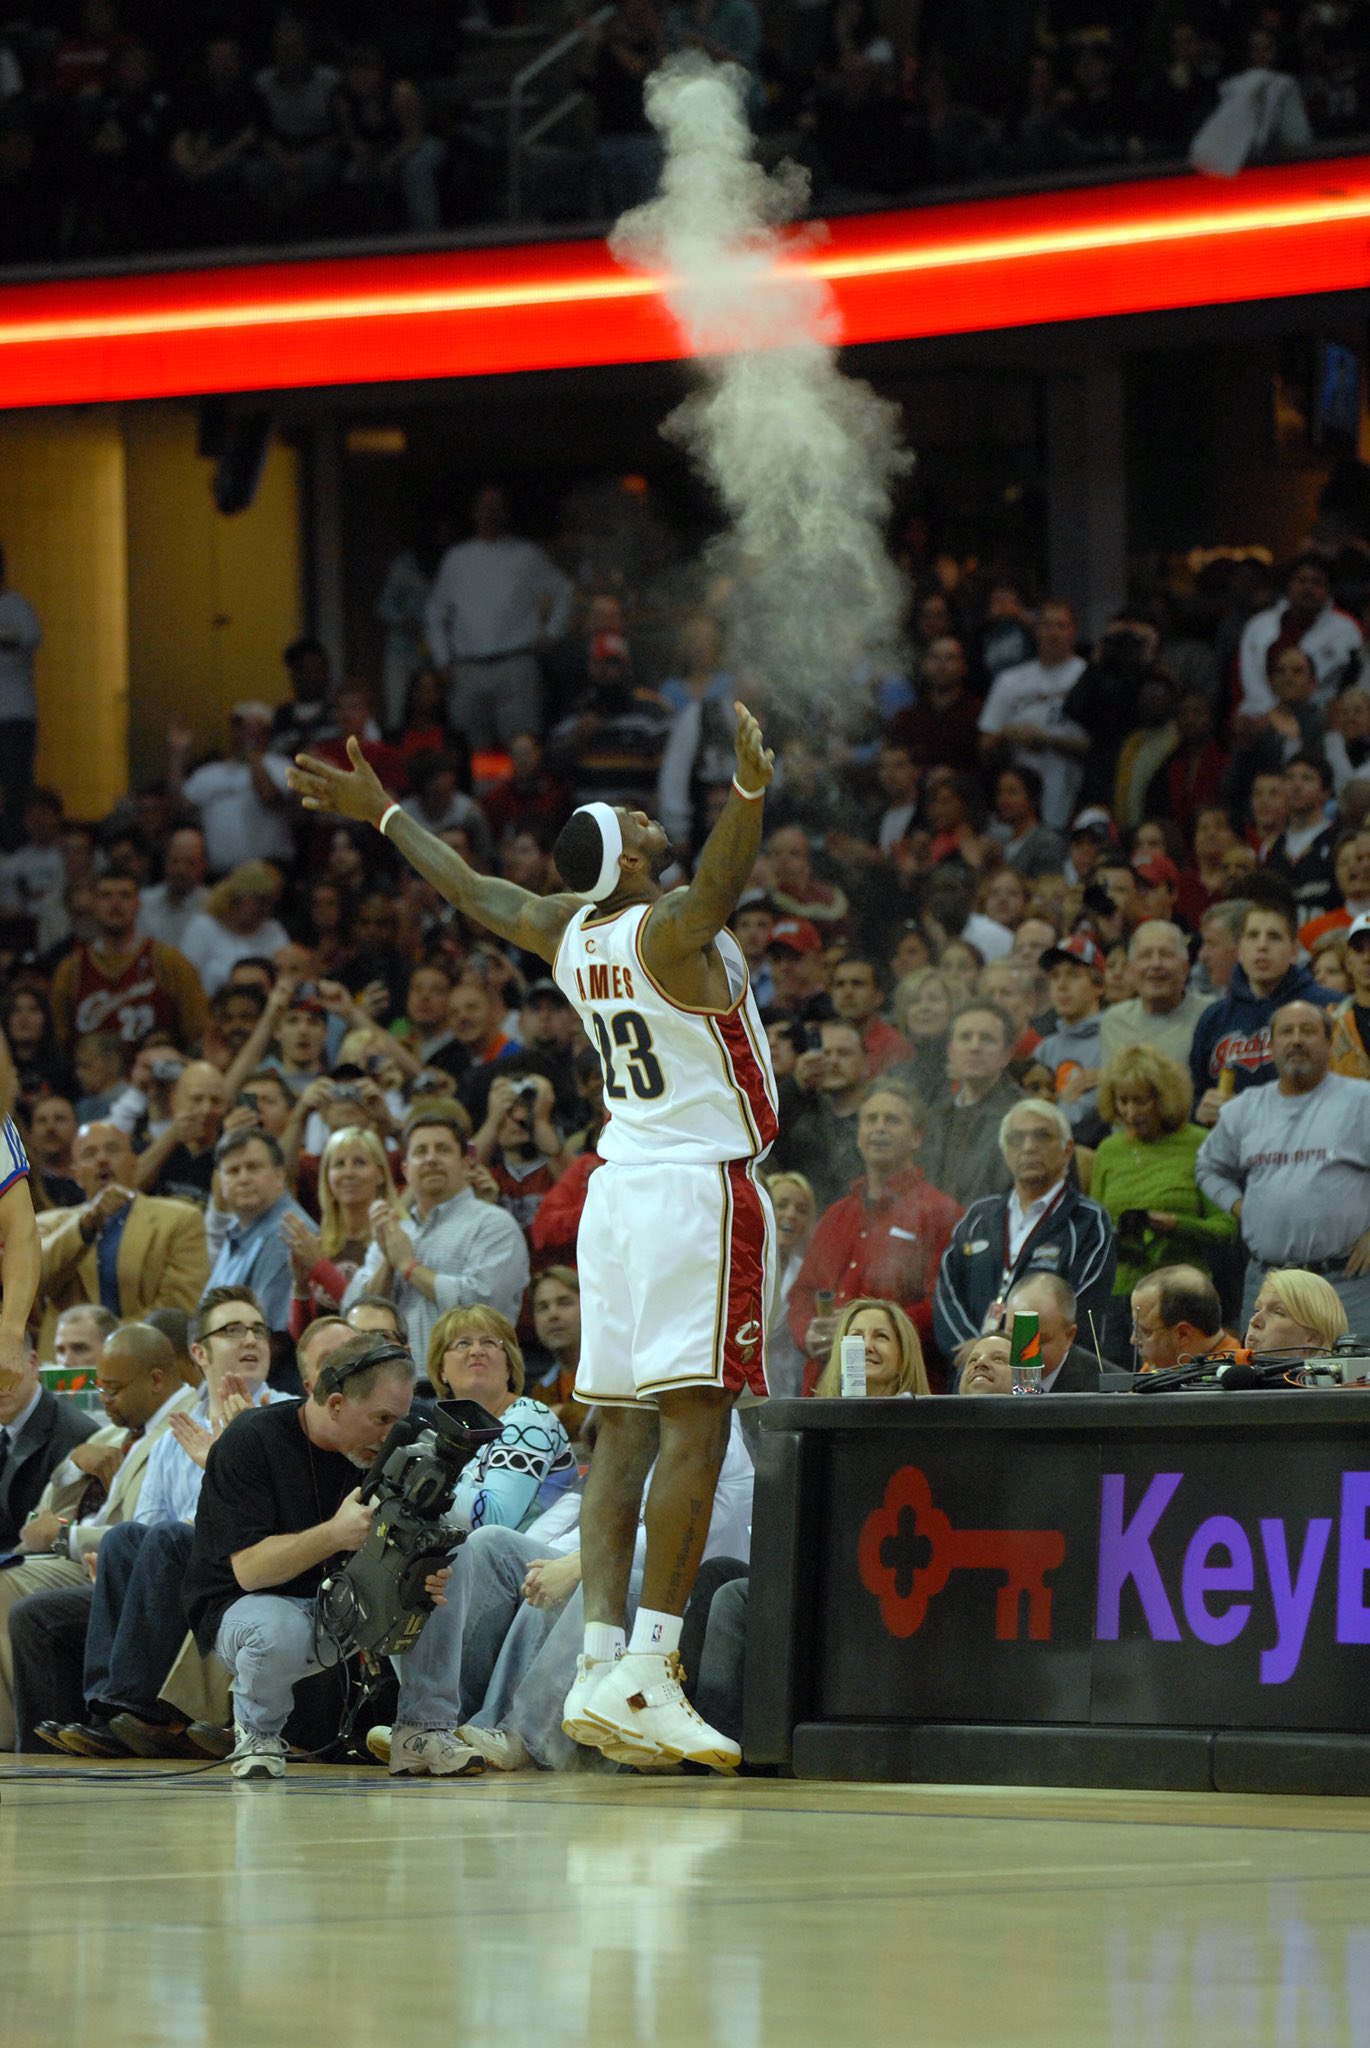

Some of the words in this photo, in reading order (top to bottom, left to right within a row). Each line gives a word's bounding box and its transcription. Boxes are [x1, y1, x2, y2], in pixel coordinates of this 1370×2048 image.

[575, 963, 635, 1002] AMES
[592, 1010, 666, 1100] 23
[1211, 1028, 1274, 1074] Indi
